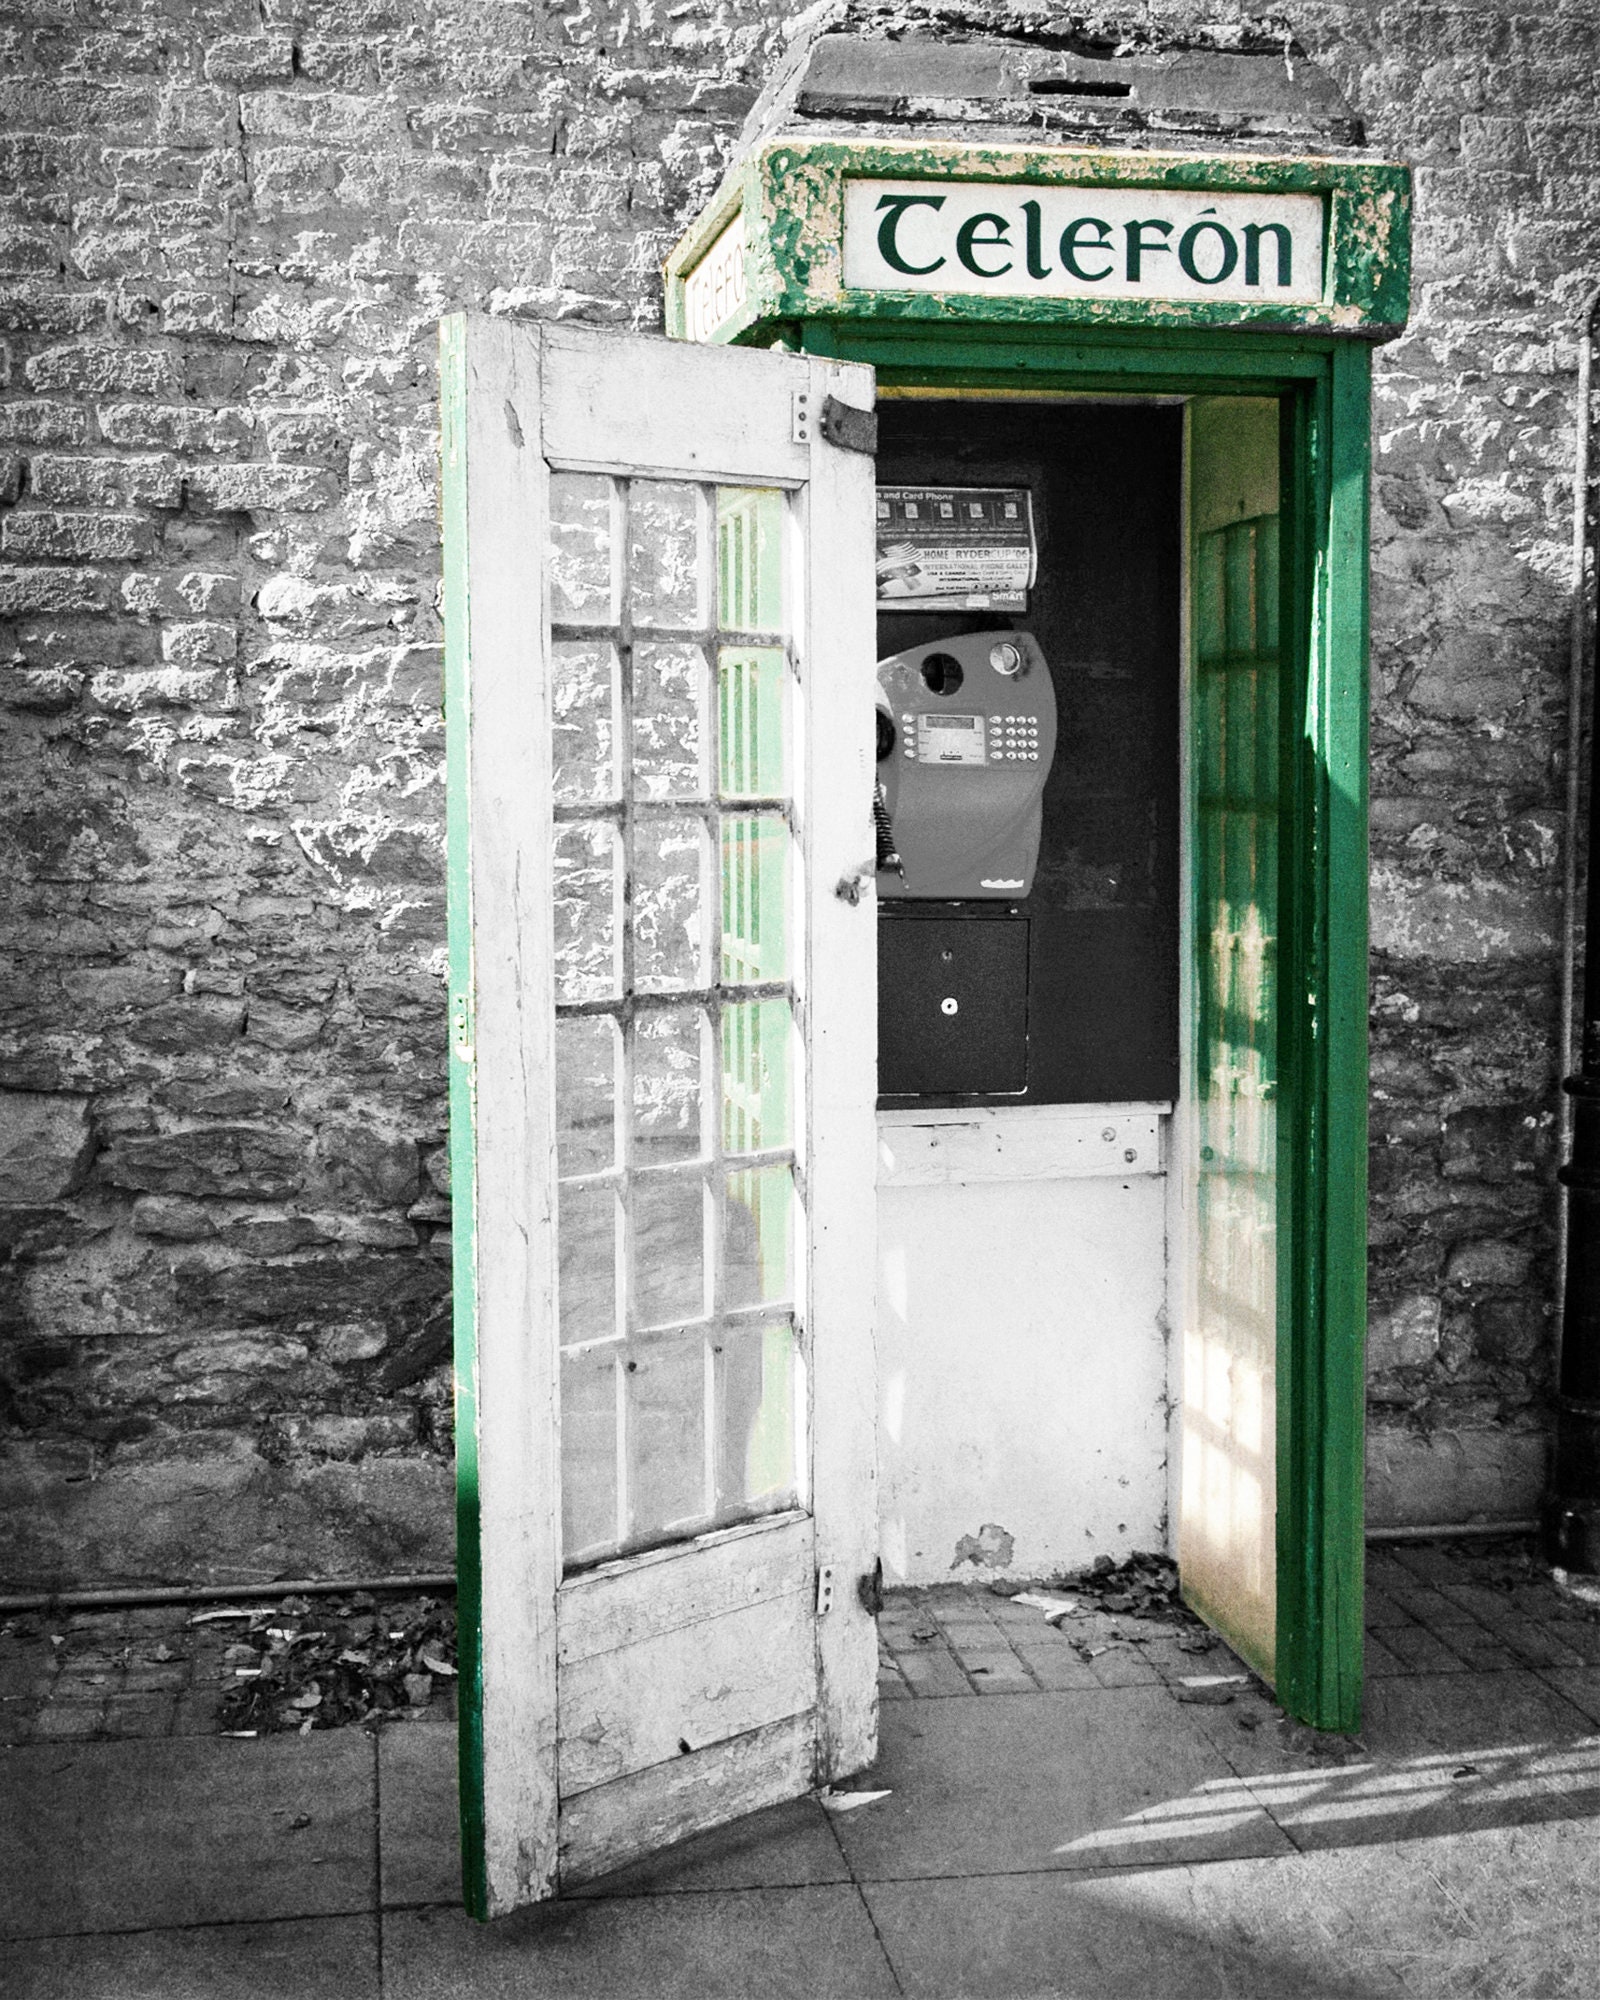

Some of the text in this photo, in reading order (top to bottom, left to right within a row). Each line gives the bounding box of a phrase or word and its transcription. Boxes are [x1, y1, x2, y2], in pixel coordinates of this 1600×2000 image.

[884, 491, 900, 499] and
[902, 491, 924, 500] Card
[925, 492, 954, 501] Phone
[924, 550, 949, 560] HOME
